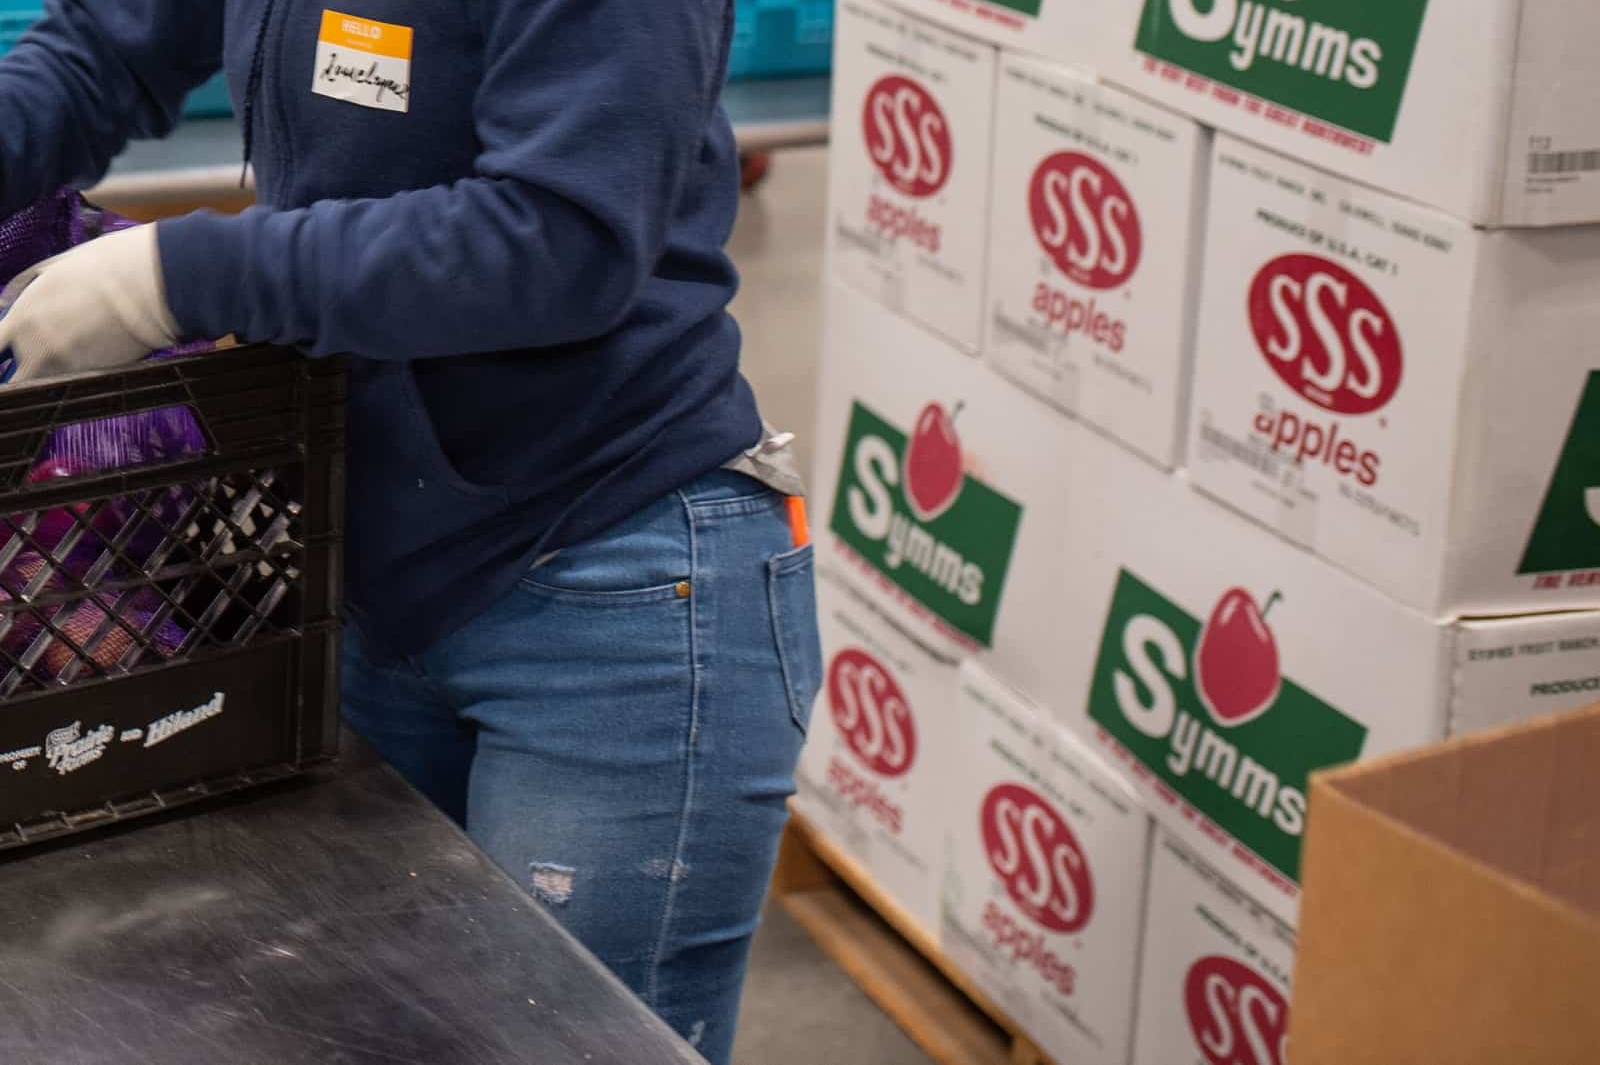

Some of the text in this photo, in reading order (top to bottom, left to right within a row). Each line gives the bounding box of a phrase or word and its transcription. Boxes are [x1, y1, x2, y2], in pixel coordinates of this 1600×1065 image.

[342, 19, 382, 39] HELLO
[872, 87, 942, 184] SSS
[866, 194, 940, 254] apples
[1042, 166, 1127, 275] SSS
[1032, 282, 1127, 353] apples
[1267, 272, 1383, 398] SSS
[1253, 410, 1381, 486] apples
[848, 434, 985, 605] Symms
[836, 662, 907, 767] SSS
[1113, 613, 1306, 835] Symms
[993, 798, 1080, 921] SSS
[983, 901, 1076, 996] apples
[1201, 972, 1292, 1065] SS
